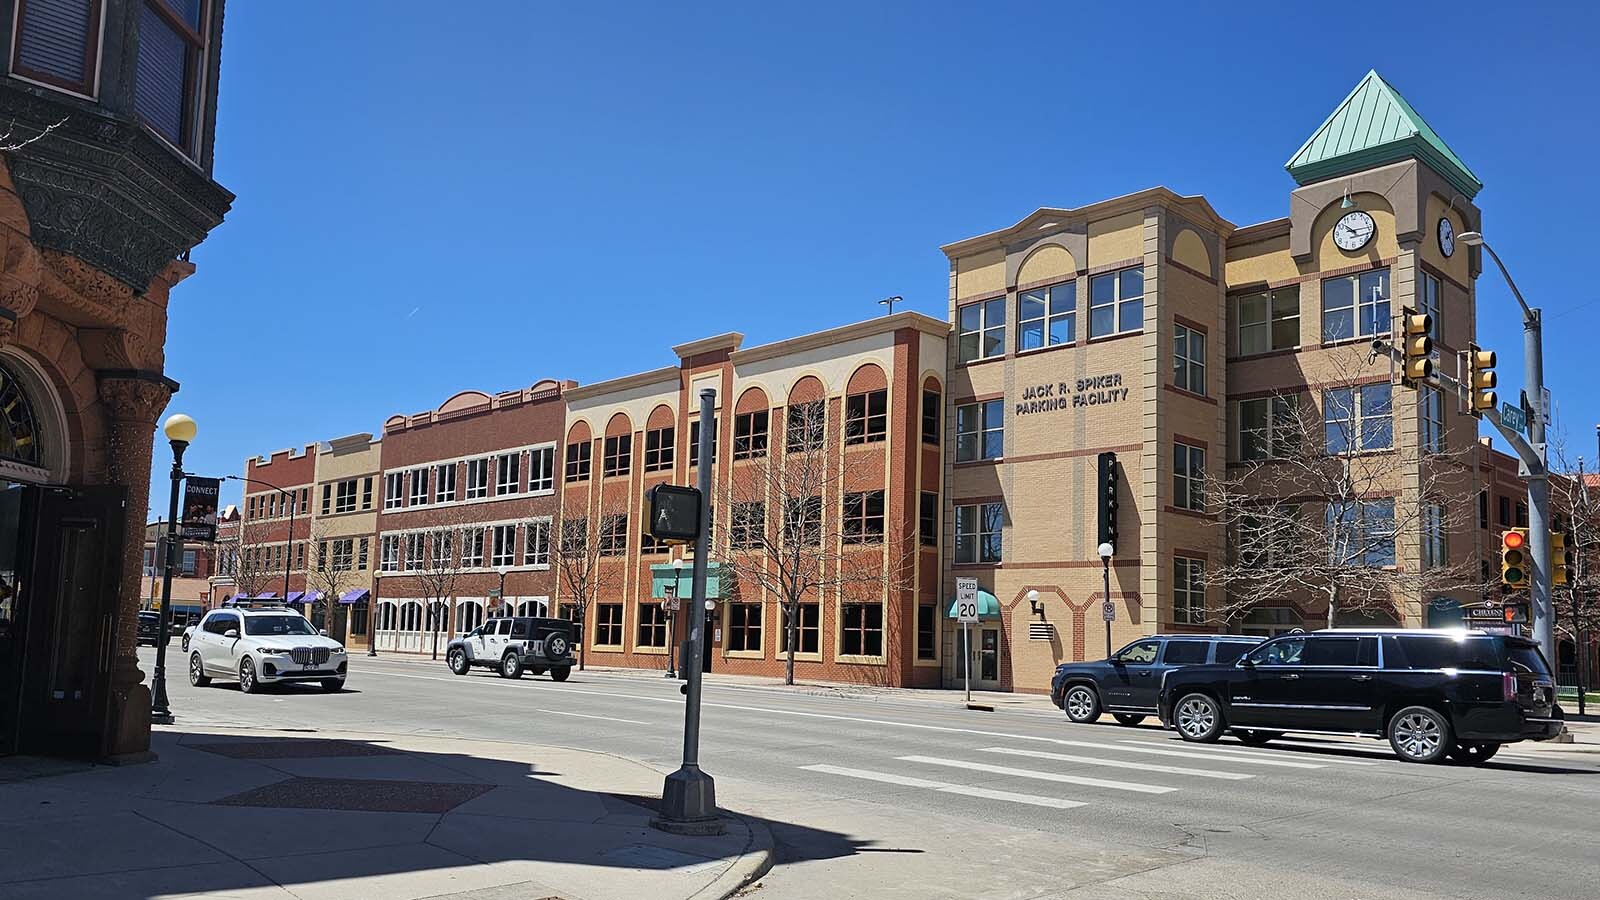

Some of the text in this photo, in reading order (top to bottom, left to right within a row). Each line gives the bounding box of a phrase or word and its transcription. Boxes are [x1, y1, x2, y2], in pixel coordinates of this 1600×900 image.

[1022, 373, 1122, 400] JACK R. SPIKER
[1016, 388, 1129, 416] PARKING FACILITY
[1503, 403, 1519, 430] Carey
[186, 485, 218, 495] CONNECT
[958, 582, 976, 590] SPEED
[960, 603, 976, 617] 20
